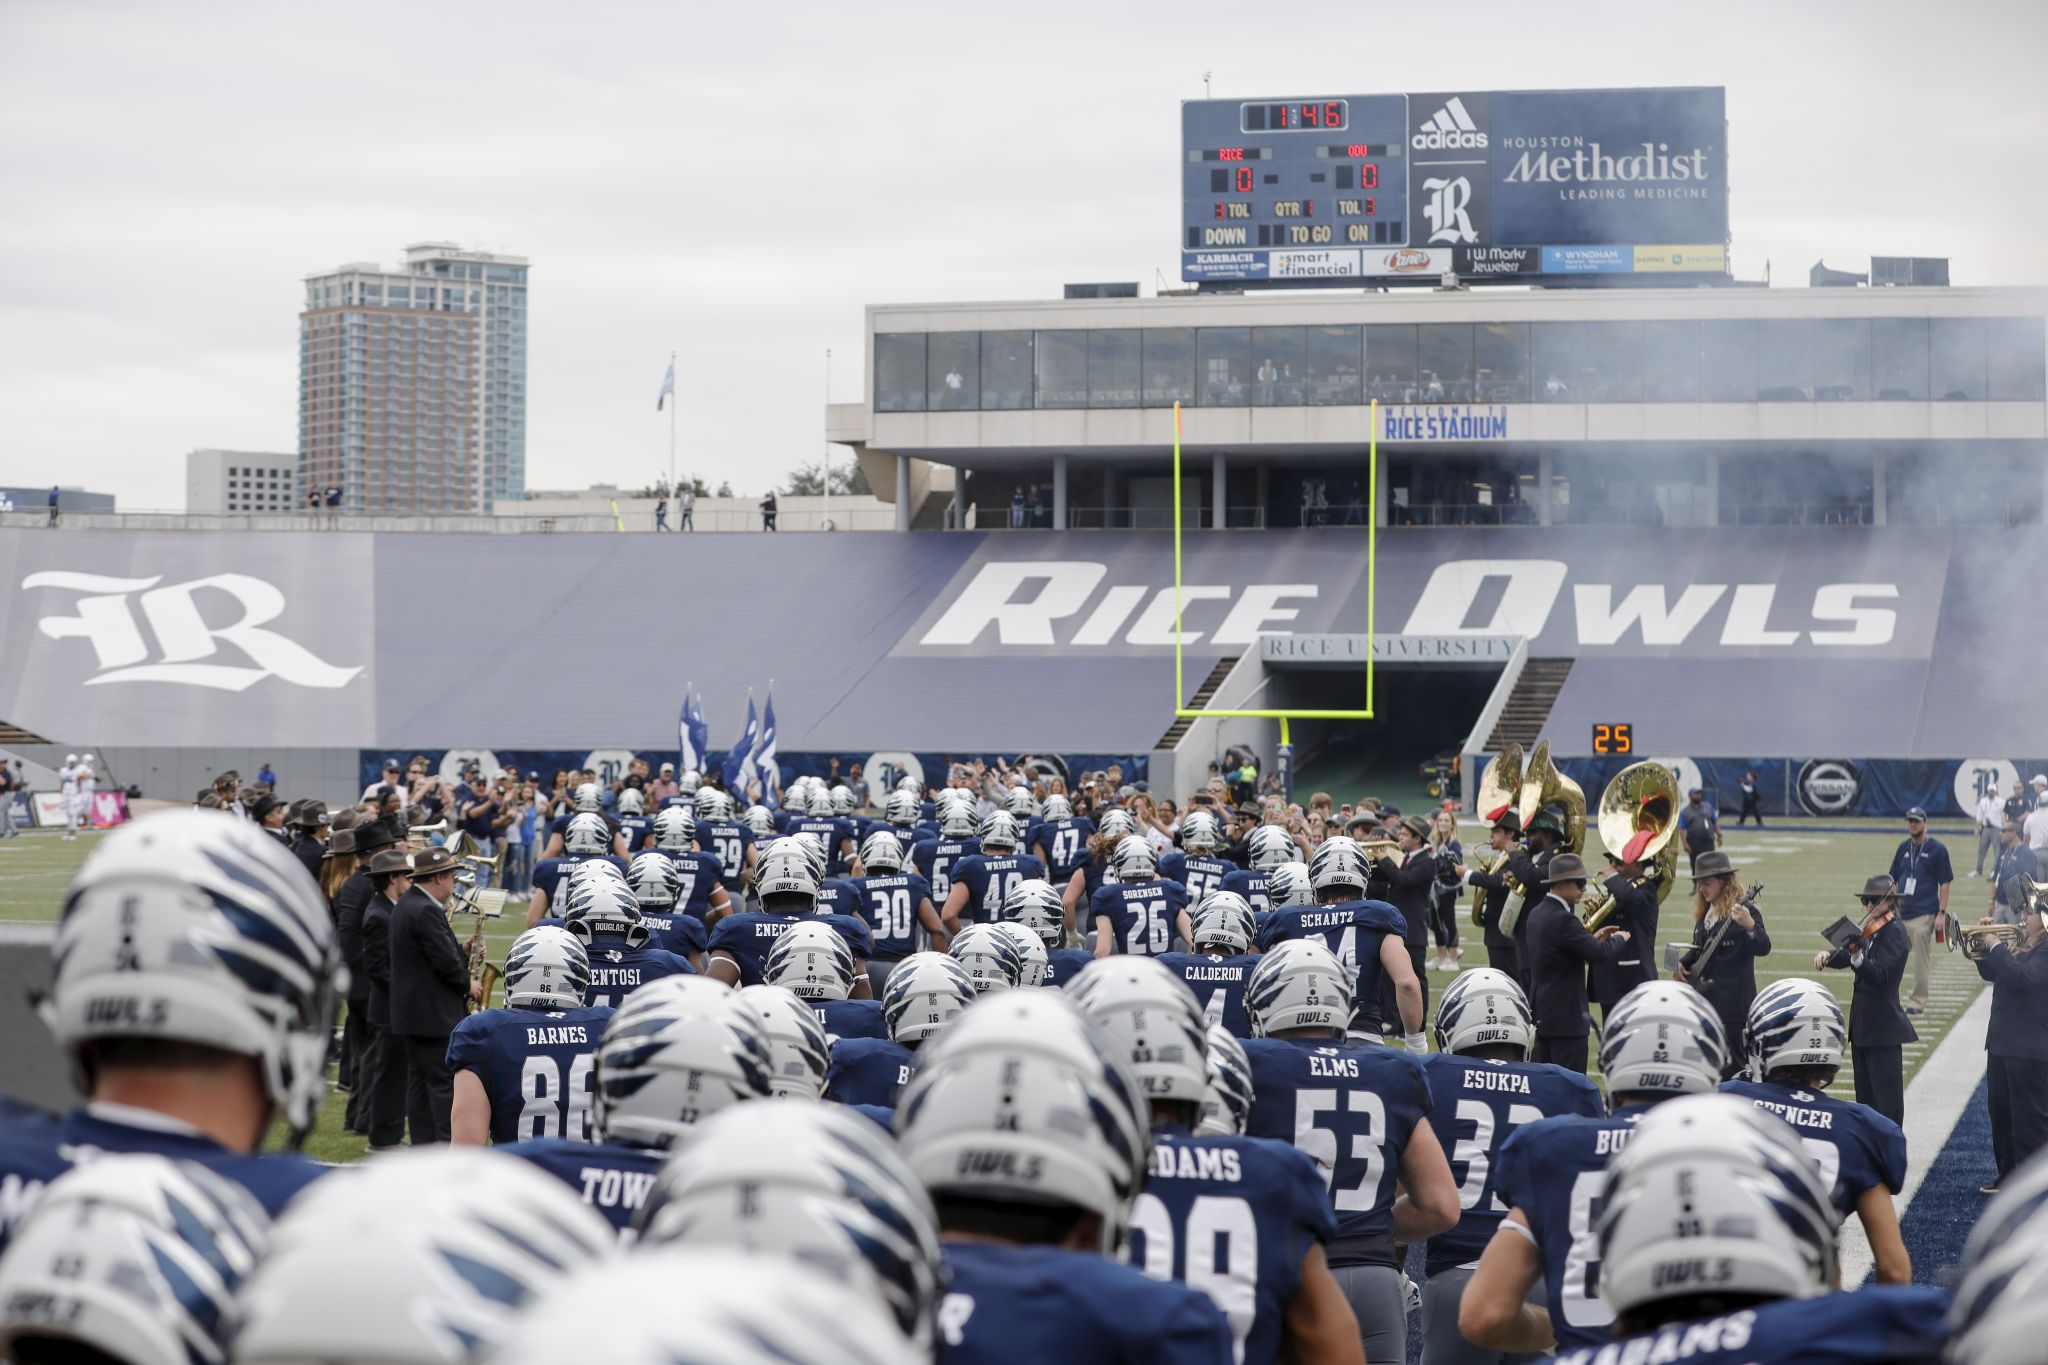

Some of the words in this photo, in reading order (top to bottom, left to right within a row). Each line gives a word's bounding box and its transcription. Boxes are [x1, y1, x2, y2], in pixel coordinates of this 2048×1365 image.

[1412, 129, 1488, 150] adidas
[1503, 136, 1584, 148] HOUSTON
[1219, 149, 1243, 161] RICE
[1503, 142, 1709, 183] Methodist
[1237, 167, 1252, 192] 0
[1362, 163, 1377, 189] 0
[1560, 188, 1626, 200] LEADING
[1634, 187, 1709, 200] MEDICINE
[1228, 203, 1250, 218] TOL
[1275, 201, 1300, 217] QTR
[1339, 200, 1360, 216] TOL
[1366, 198, 1376, 216] 3
[1422, 176, 1479, 244] R
[1205, 228, 1246, 245] DOWN
[1291, 226, 1310, 243] TO
[1312, 225, 1332, 242] GO
[1348, 224, 1369, 241] ON
[1196, 253, 1254, 263] KARBACH
[1286, 252, 1331, 263] smart
[1489, 248, 1528, 260] Marks
[1565, 250, 1618, 259] WYNDHAM
[1285, 263, 1352, 275] financial
[1472, 261, 1519, 273] Jewelers
[1385, 406, 1471, 417] WELCOME
[1489, 406, 1507, 417] TO
[1385, 417, 1423, 440] RICE
[1427, 416, 1507, 439] STADIUM
[22, 570, 366, 691] R
[1270, 640, 1334, 656] RICE
[1347, 639, 1517, 656] UNIVERSITY
[1594, 725, 1630, 753] 25
[1808, 783, 1853, 792] NISSAN
[1052, 829, 1079, 867] 47
[672, 860, 699, 871] MYERS
[984, 860, 1018, 871] WRIGHT
[1184, 860, 1224, 875] ALLDREDGE
[783, 871, 791, 879] 14
[1331, 876, 1352, 884] OWLS
[775, 882, 799, 891] OWLS
[866, 877, 908, 889] BROUSSARD
[1122, 887, 1163, 900] SORENSEN
[871, 889, 911, 940] 30
[1301, 911, 1355, 928] SCHANTZ
[595, 922, 625, 932] DOUGLAS
[1126, 900, 1169, 955] 26
[1210, 933, 1233, 944] OWLS
[805, 975, 817, 983] 43
[1185, 966, 1243, 981] CALDERON
[540, 984, 551, 993] 86
[793, 987, 825, 997] OWLS
[531, 997, 558, 1007] OWLS
[1306, 996, 1319, 1006] 53
[928, 1014, 939, 1023] 16
[1296, 1012, 1331, 1025] OWLS
[1486, 1015, 1497, 1025] 33
[527, 1026, 587, 1045] BARNES
[1476, 1029, 1509, 1043] OWLS
[1809, 1038, 1821, 1048] 32
[1800, 1053, 1829, 1064] OWLS
[1308, 1056, 1359, 1078] ELMS
[1463, 1069, 1531, 1094] ESUKPA
[1638, 1072, 1684, 1089] OWLS
[1294, 1088, 1386, 1212] 53
[1148, 1144, 1242, 1182] DAMS
[1651, 1257, 1737, 1289] OWLS
